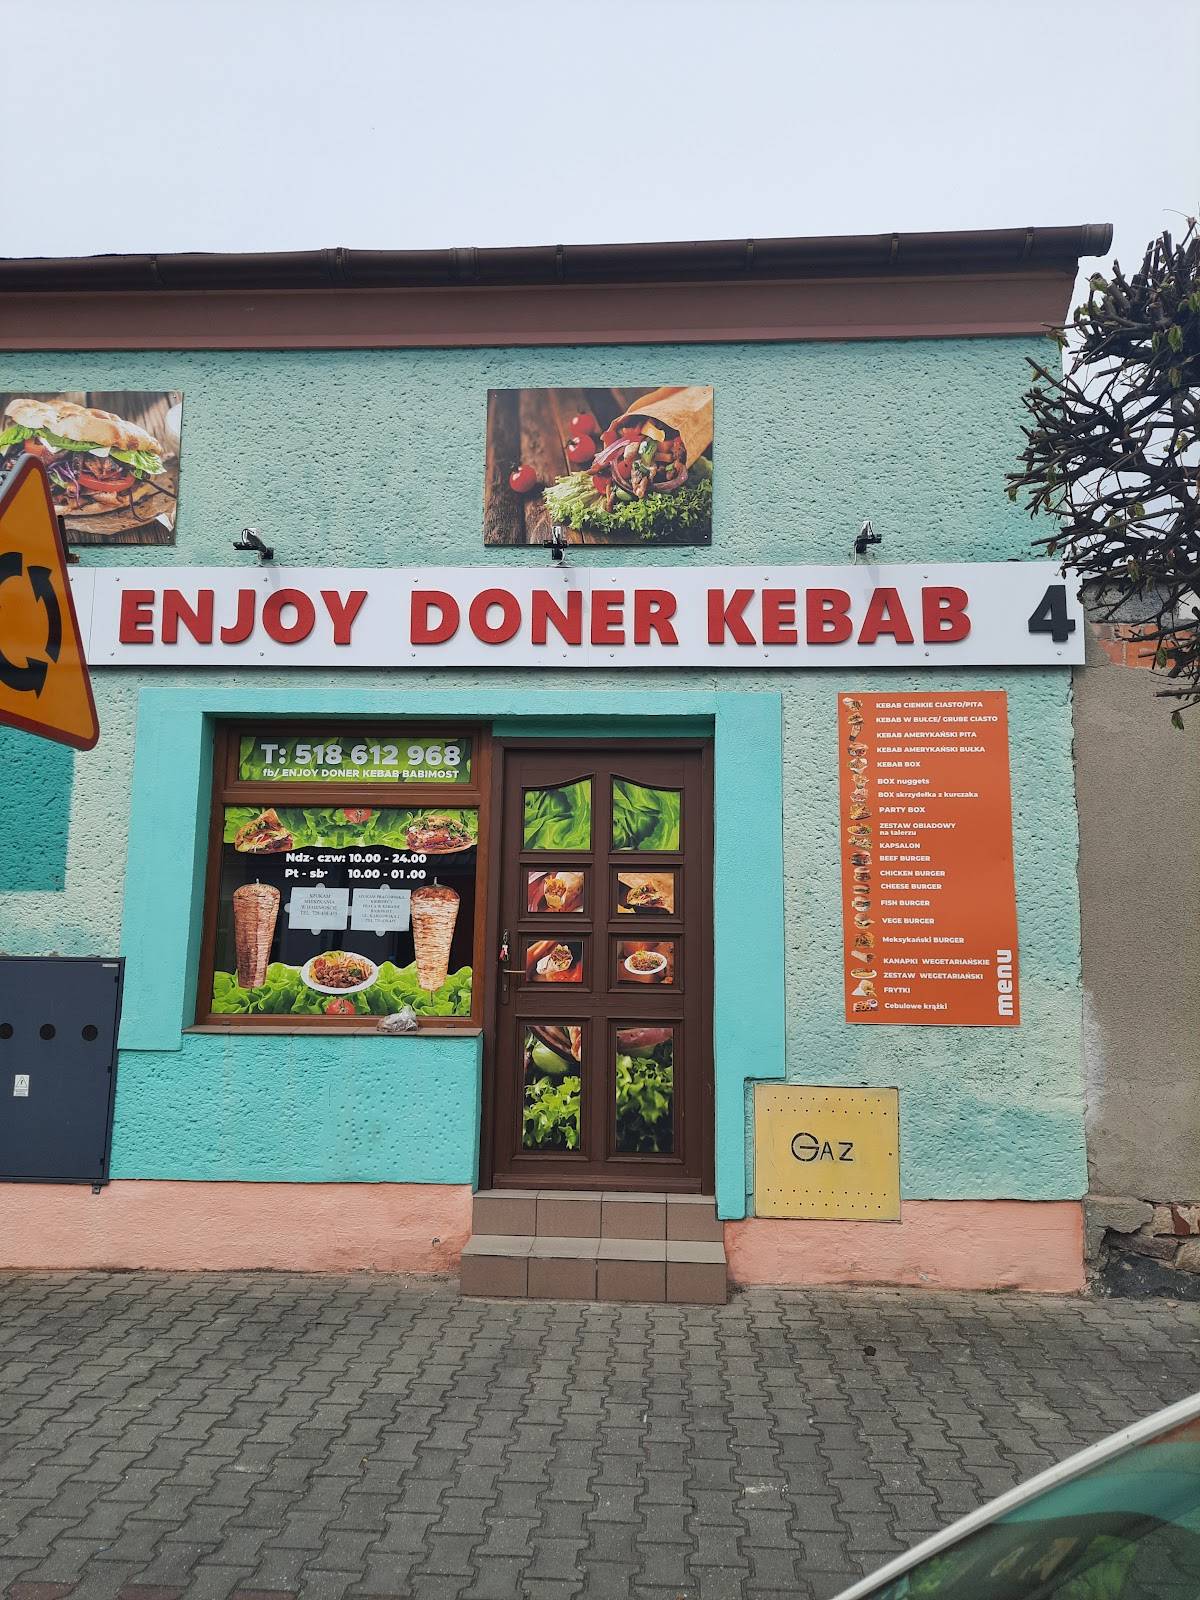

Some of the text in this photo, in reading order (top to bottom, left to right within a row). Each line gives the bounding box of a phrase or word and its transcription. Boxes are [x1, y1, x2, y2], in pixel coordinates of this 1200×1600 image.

[118, 586, 972, 646] ENJOY DONER KEBAB
[1028, 584, 1076, 643] 4
[261, 744, 460, 766] T: 518 612 968
[263, 769, 459, 779] fb/ ENJOY DONER KEBAB BABIMOST
[896, 779, 930, 787] nuggets
[286, 853, 313, 863] Ndz-
[317, 854, 346, 863] czw:
[348, 853, 381, 863] 10.00
[392, 853, 427, 864] 24.00
[285, 869, 299, 878] Pt
[348, 869, 380, 879] 10.00
[882, 937, 932, 945] Meksykański
[996, 949, 1013, 1016] menu
[924, 1003, 947, 1011] krążki
